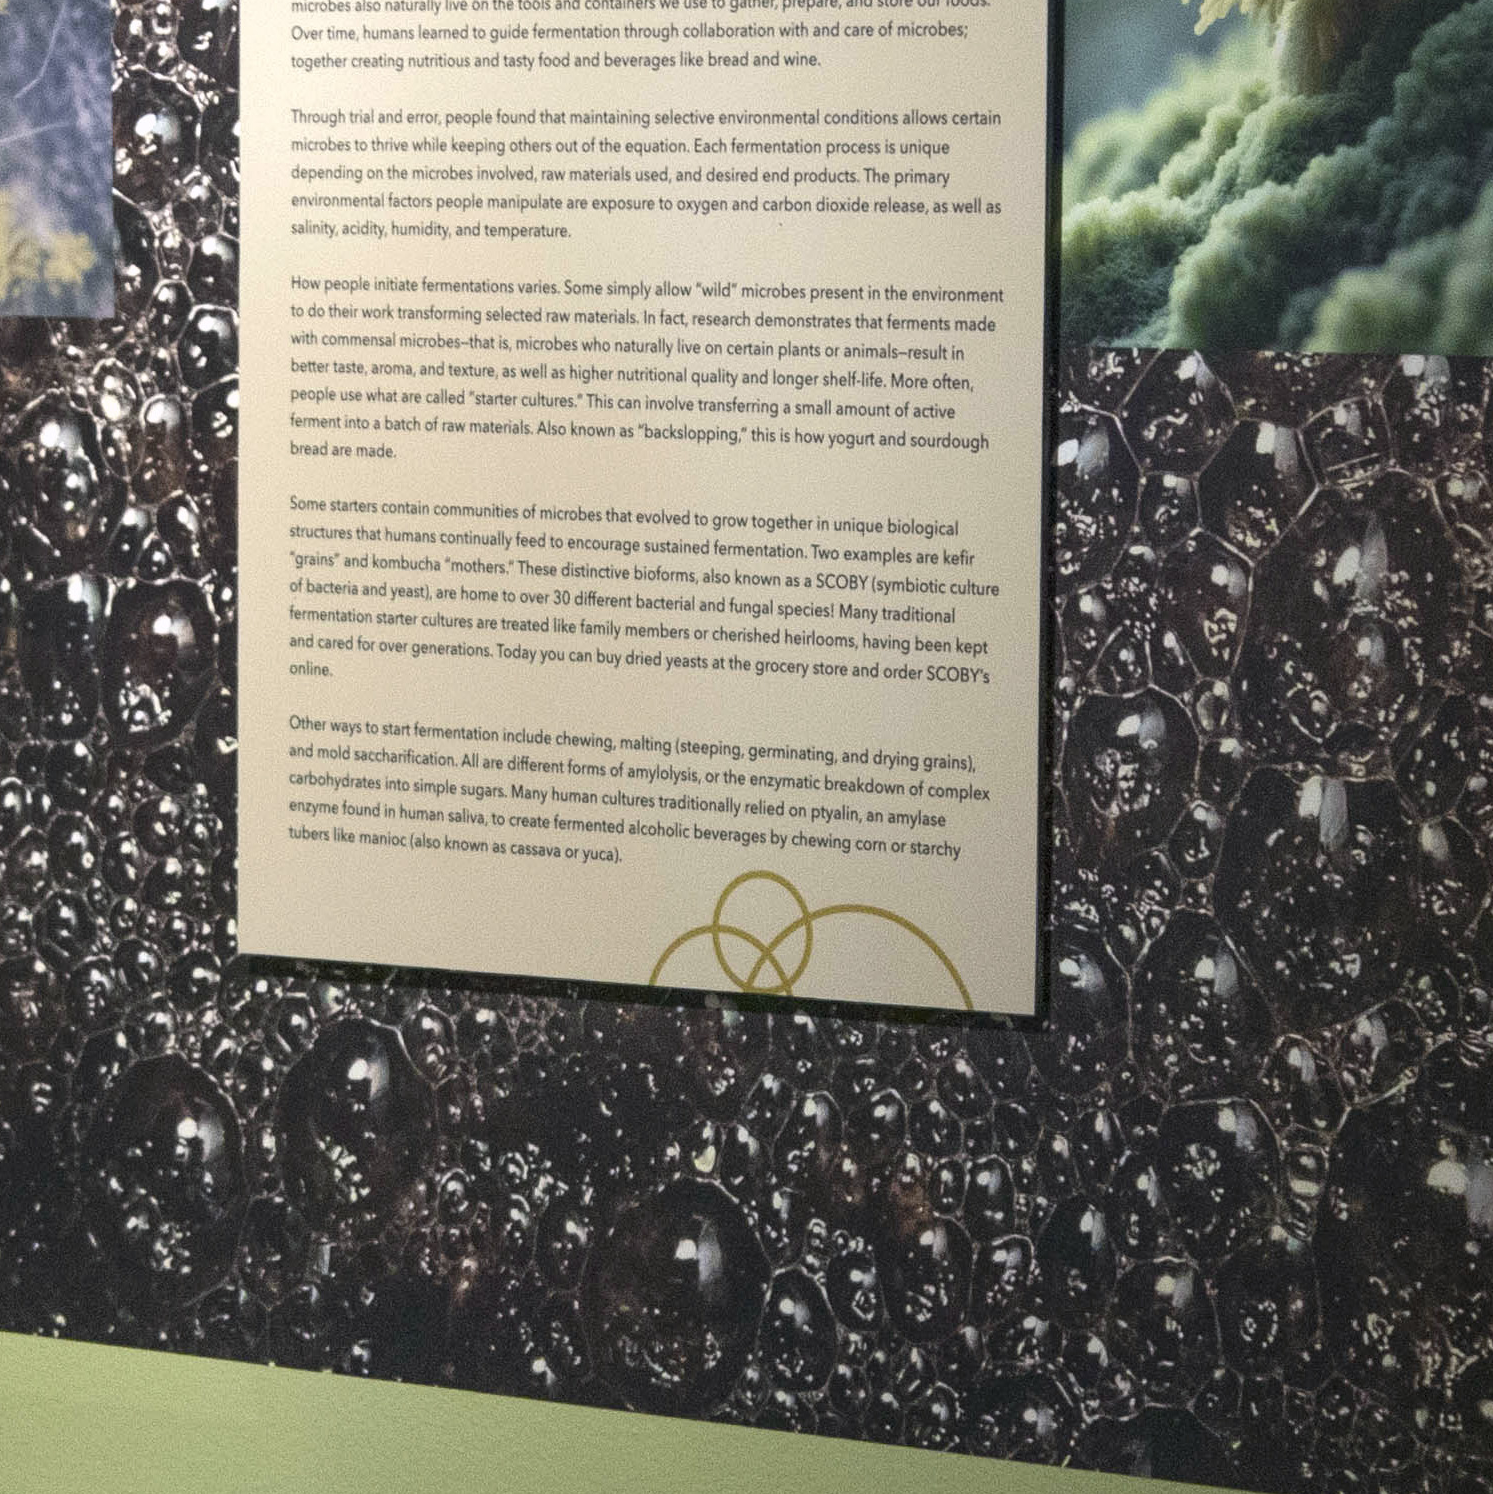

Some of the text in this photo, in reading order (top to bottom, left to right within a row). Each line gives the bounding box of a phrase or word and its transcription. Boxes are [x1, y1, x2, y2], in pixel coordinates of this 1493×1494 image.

[291, 108, 1001, 129] Through trial and error, people found that maintaining selective environmental conditions allows certain
[291, 164, 949, 188] depending on the microbes involved, raw materials used, and desired end products. The primary
[290, 303, 995, 332] to do their work transforming selected raw materials. In fact, research demonstrates that ferments made
[290, 440, 395, 459] bread are made.
[290, 494, 958, 541] Some starters contain communities of microbes that evolved to grow together in unique biological
[289, 576, 302, 593] of
[306, 578, 358, 595] bacteria
[362, 581, 386, 597] and
[436, 588, 456, 600] are
[461, 585, 498, 602] home
[502, 590, 516, 603] to
[519, 592, 549, 604] over
[553, 589, 570, 606] 30
[574, 589, 632, 609] different
[636, 593, 695, 611] bacterial
[699, 596, 725, 613] and
[729, 596, 773, 619] fungal
[777, 600, 834, 621] species!
[839, 602, 878, 624] Many
[881, 604, 955, 624] traditional
[289, 659, 333, 677] online.
[289, 714, 326, 731] Other
[330, 721, 362, 737] ways
[365, 721, 379, 735] to
[382, 723, 410, 737] start
[413, 721, 499, 742] fermentation
[503, 727, 551, 745] include
[555, 730, 616, 753] chewing,
[620, 734, 671, 757] malting
[748, 743, 837, 767] germinating,
[842, 747, 869, 764] and
[873, 748, 919, 772] drying
[288, 824, 329, 841] tubers
[333, 827, 355, 843] like
[359, 832, 406, 847] manioc
[444, 834, 488, 853] known
[492, 842, 506, 854] as
[510, 843, 561, 858] cassava
[565, 847, 578, 859] or
